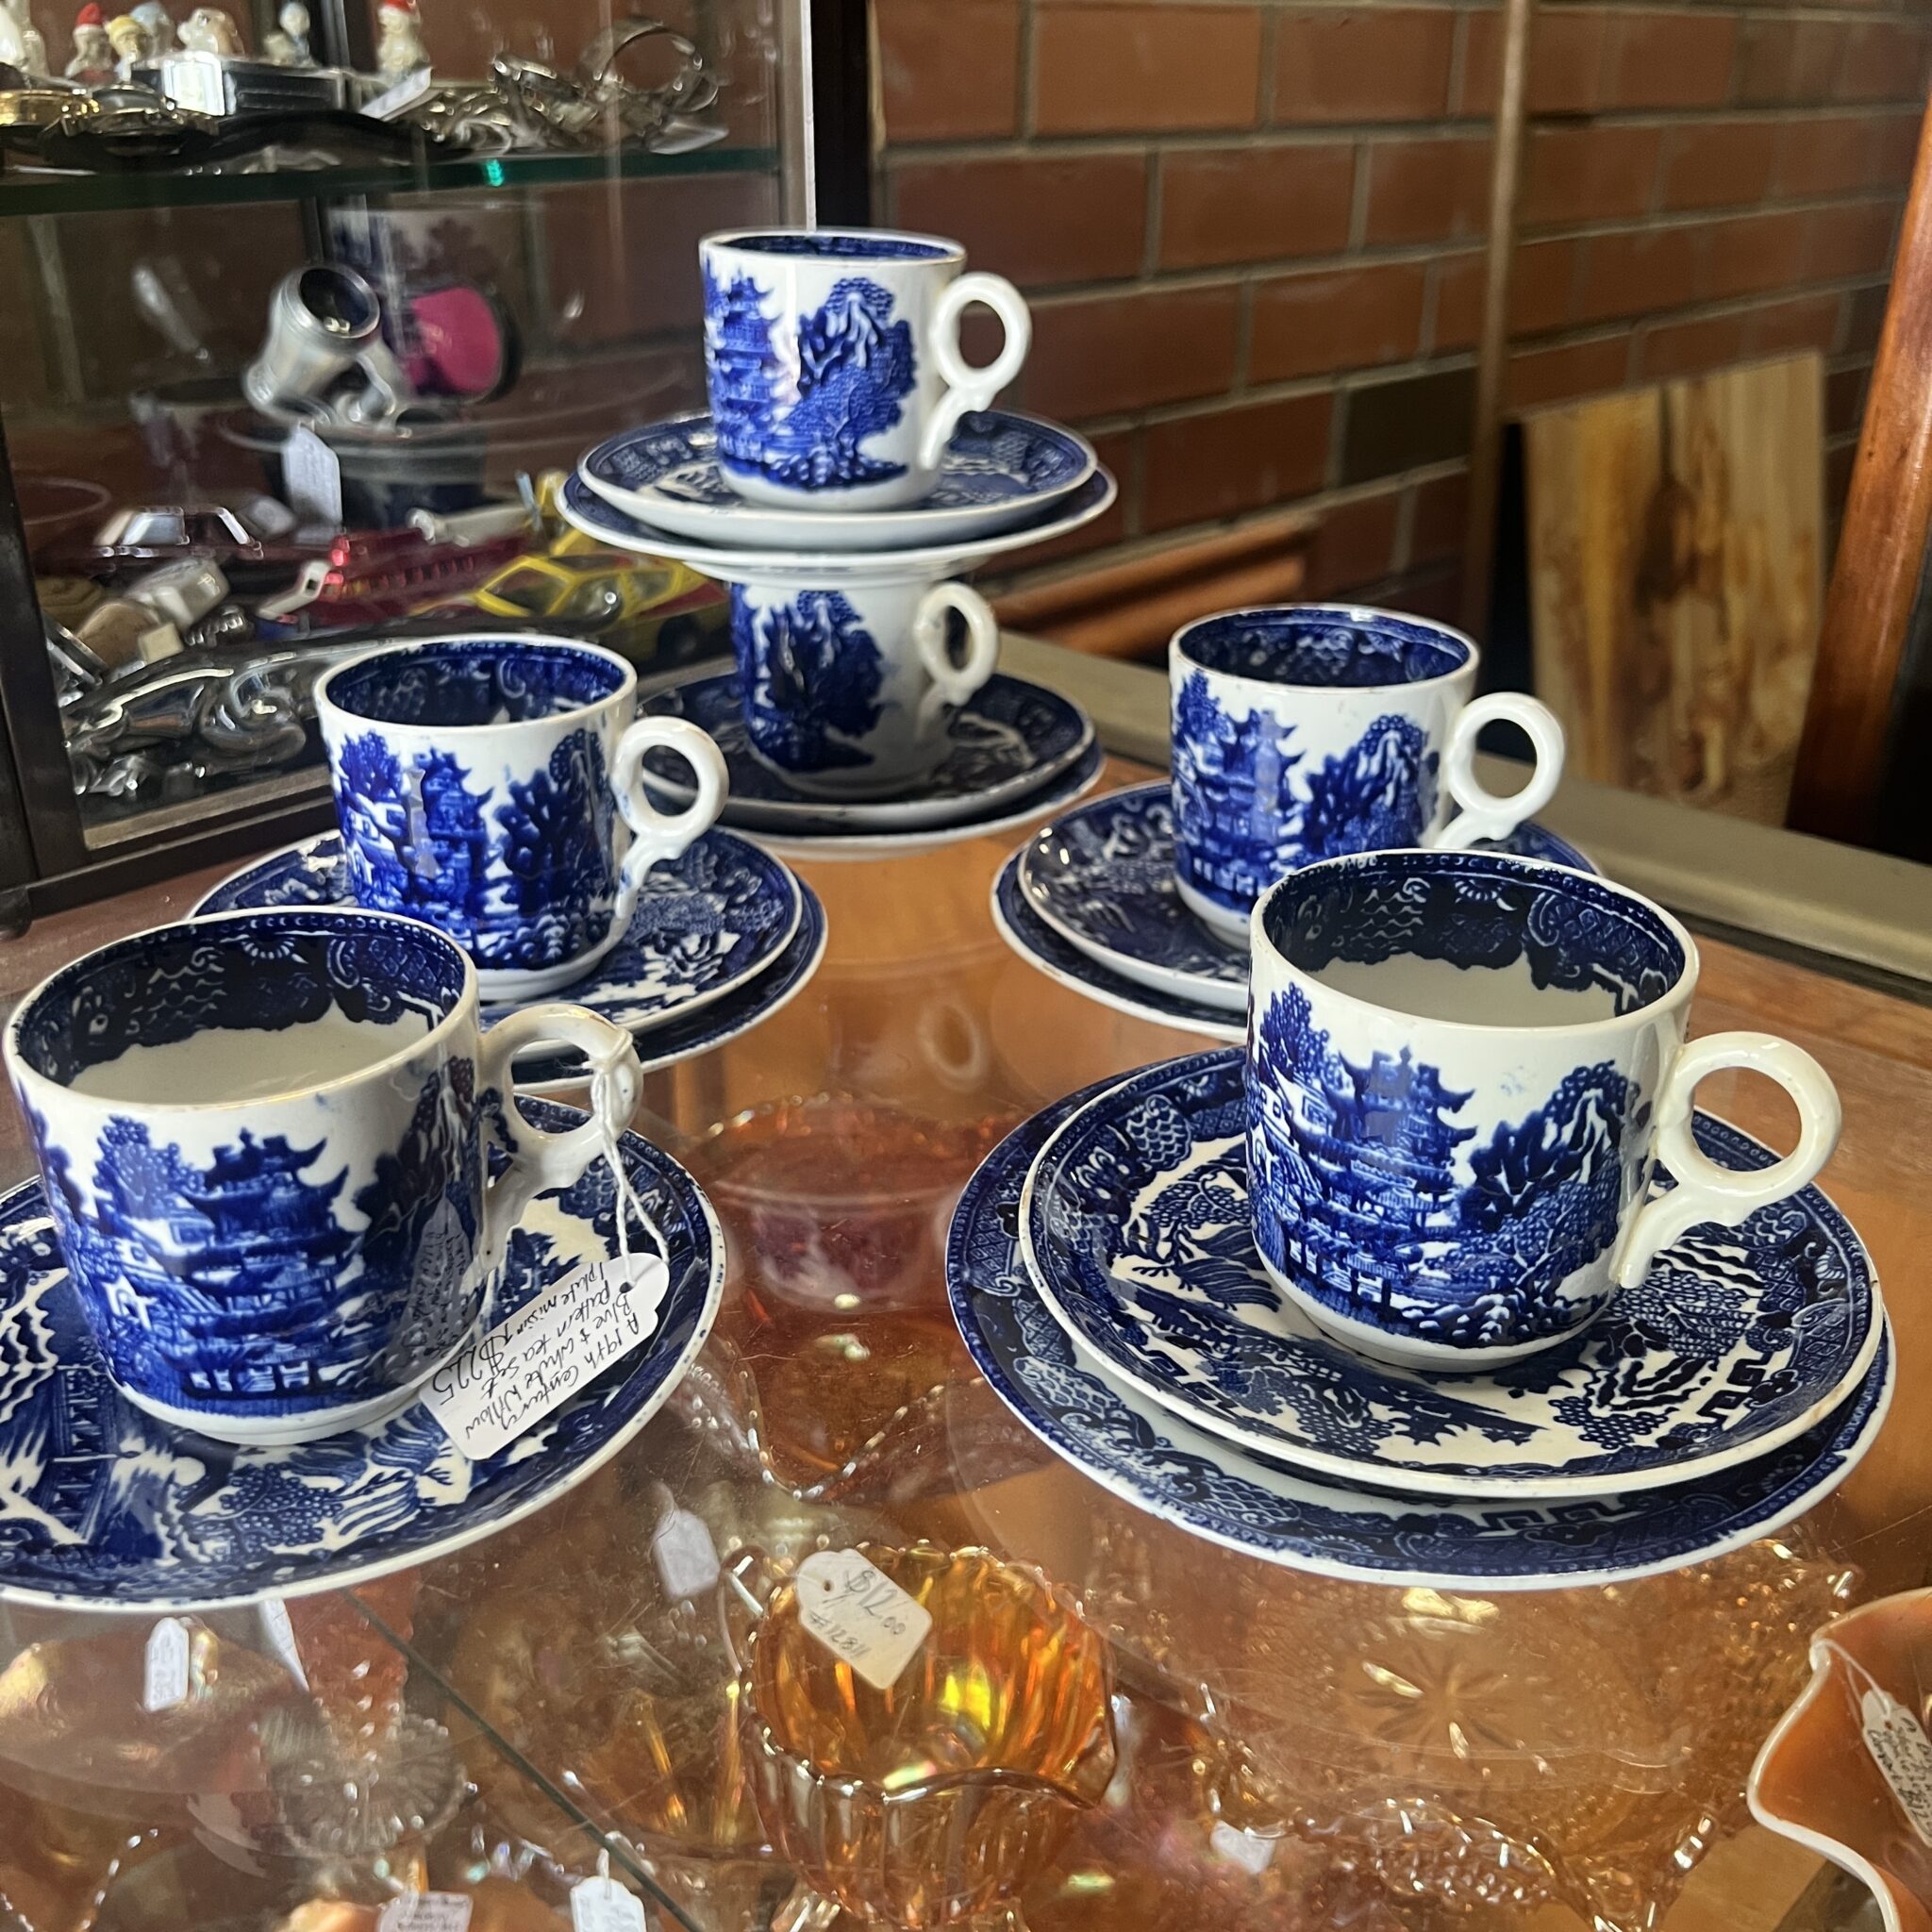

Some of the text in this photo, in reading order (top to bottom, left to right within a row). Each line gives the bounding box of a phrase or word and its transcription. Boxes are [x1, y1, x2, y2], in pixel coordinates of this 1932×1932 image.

[592, 1294, 634, 1330] Blue
[431, 1336, 506, 1406] $225
[503, 1312, 640, 1431] A 19th Century
[520, 1332, 551, 1362] tea
[465, 1384, 522, 1440] Willow
